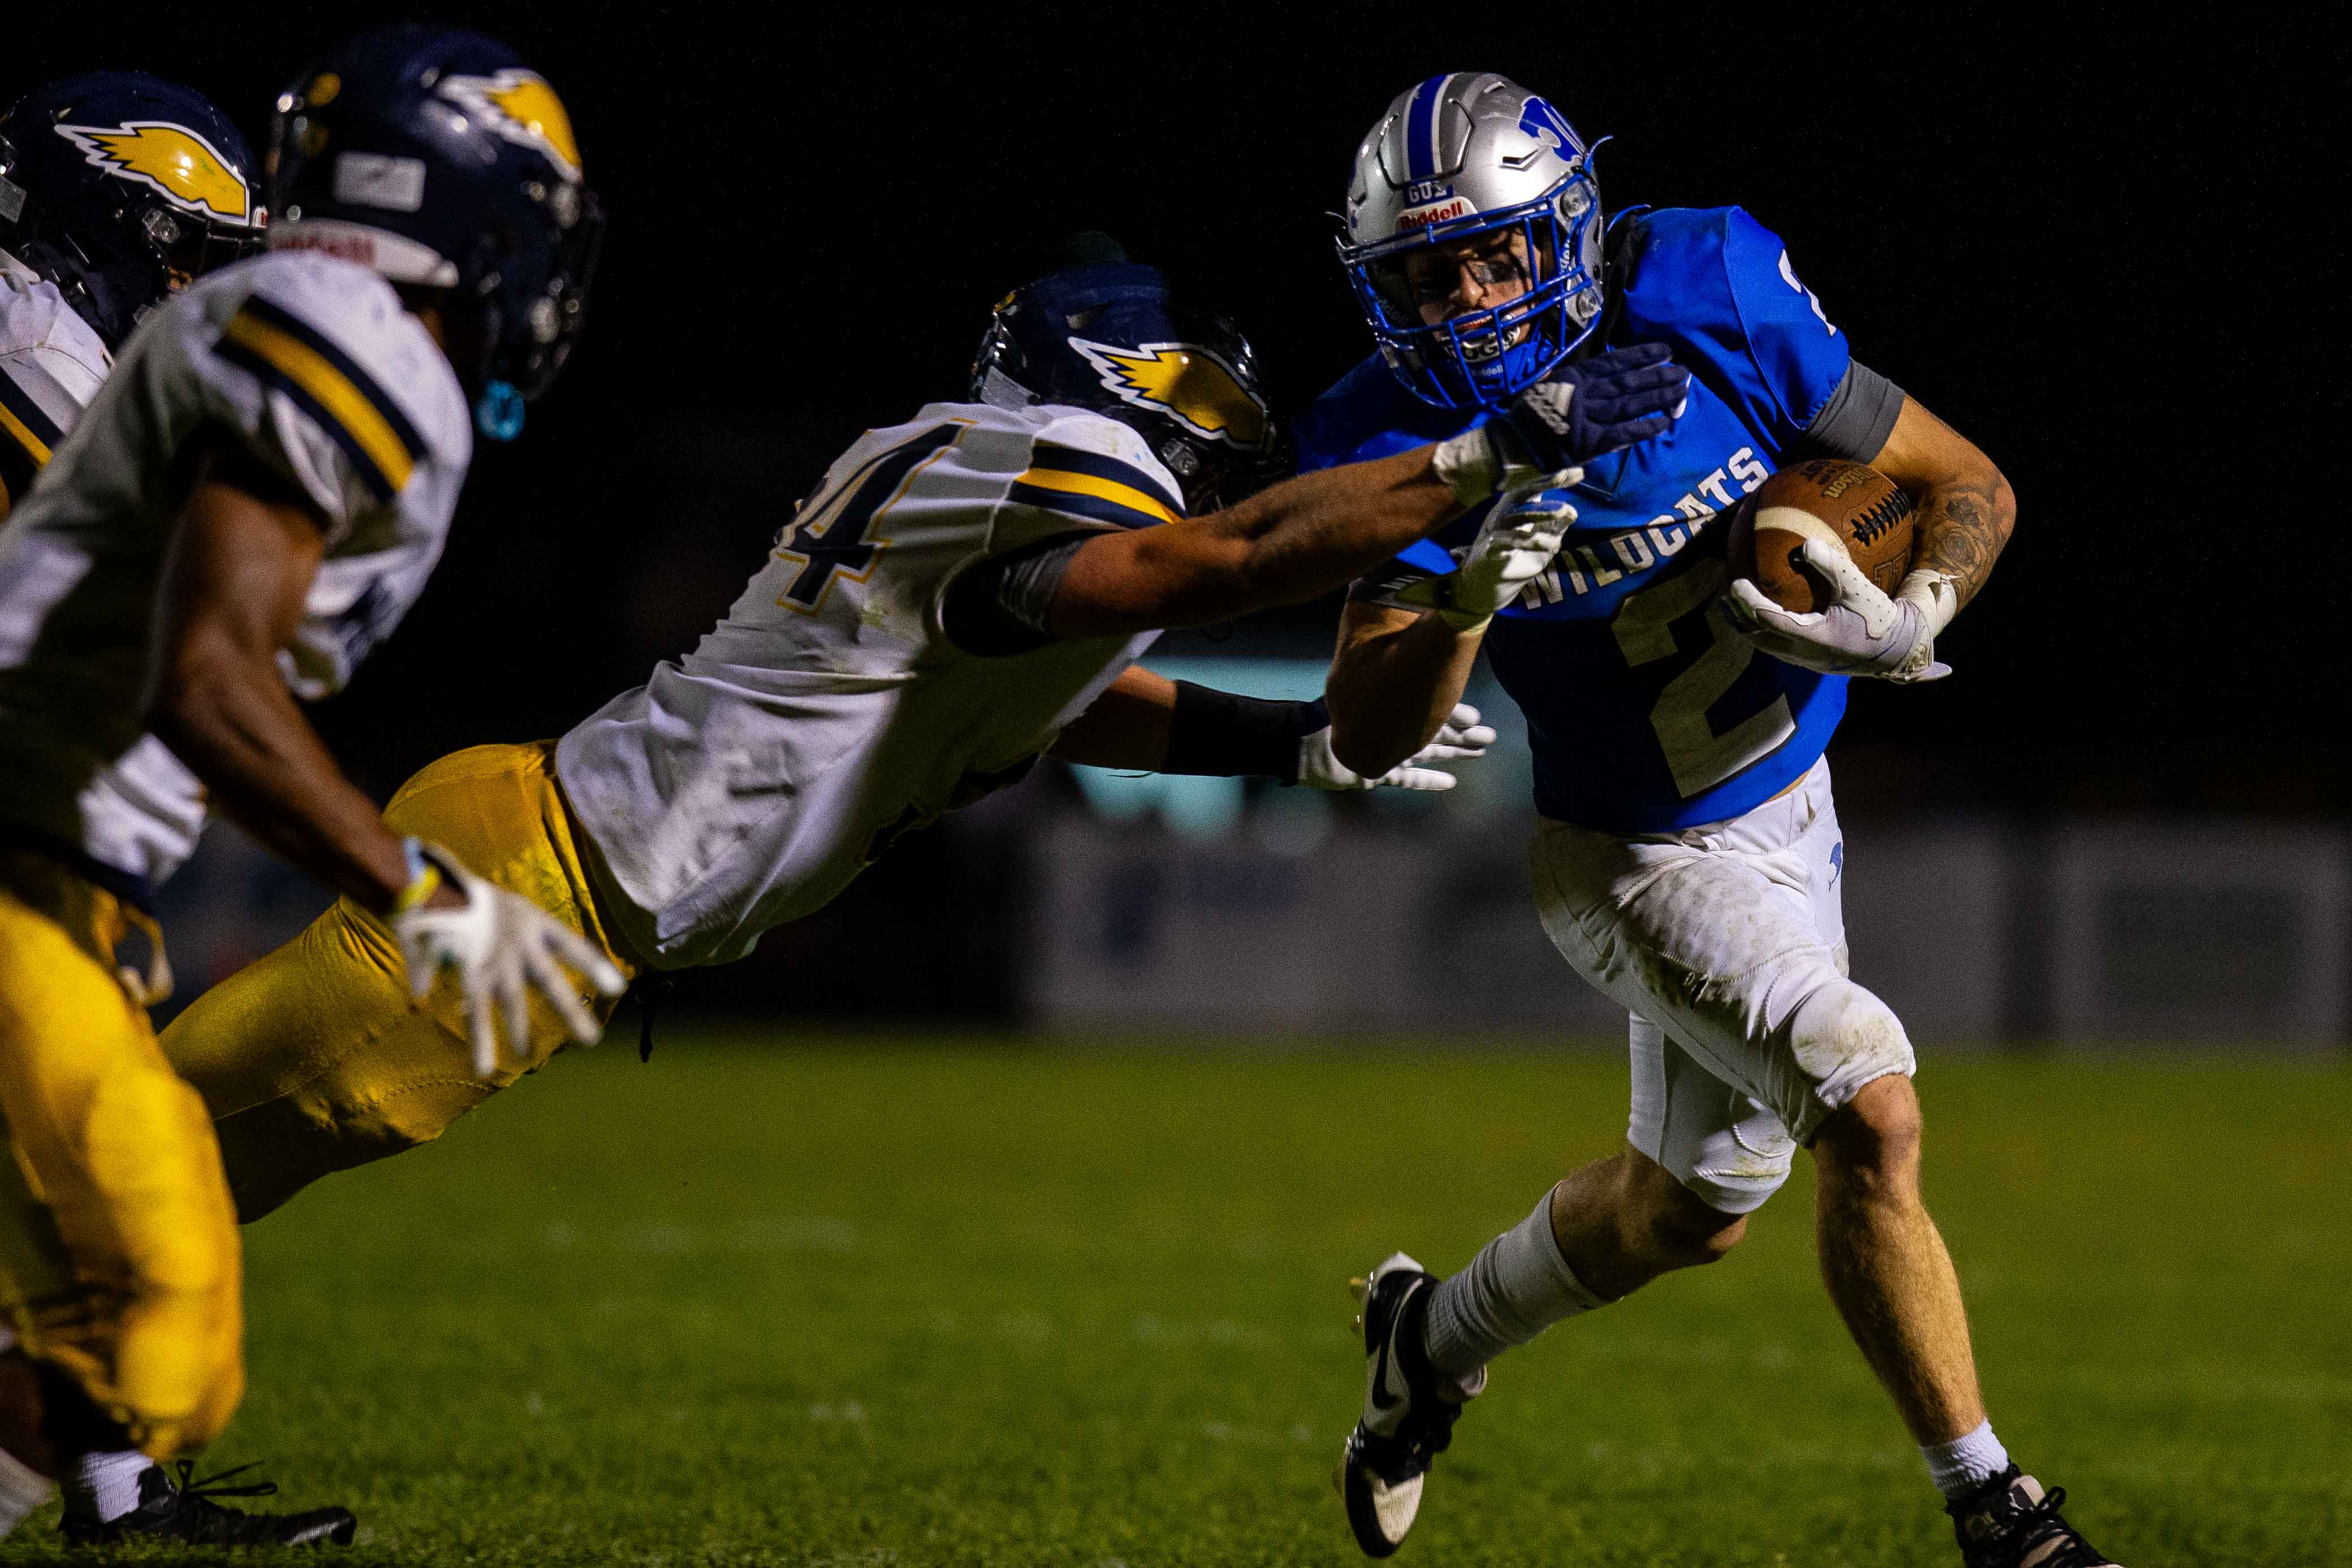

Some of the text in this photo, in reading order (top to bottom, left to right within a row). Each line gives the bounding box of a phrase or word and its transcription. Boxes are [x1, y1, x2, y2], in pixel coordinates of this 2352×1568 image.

[1399, 200, 1465, 228] Riddell
[1520, 447, 1770, 610] WILDCATS
[1611, 557, 1796, 799] 2
